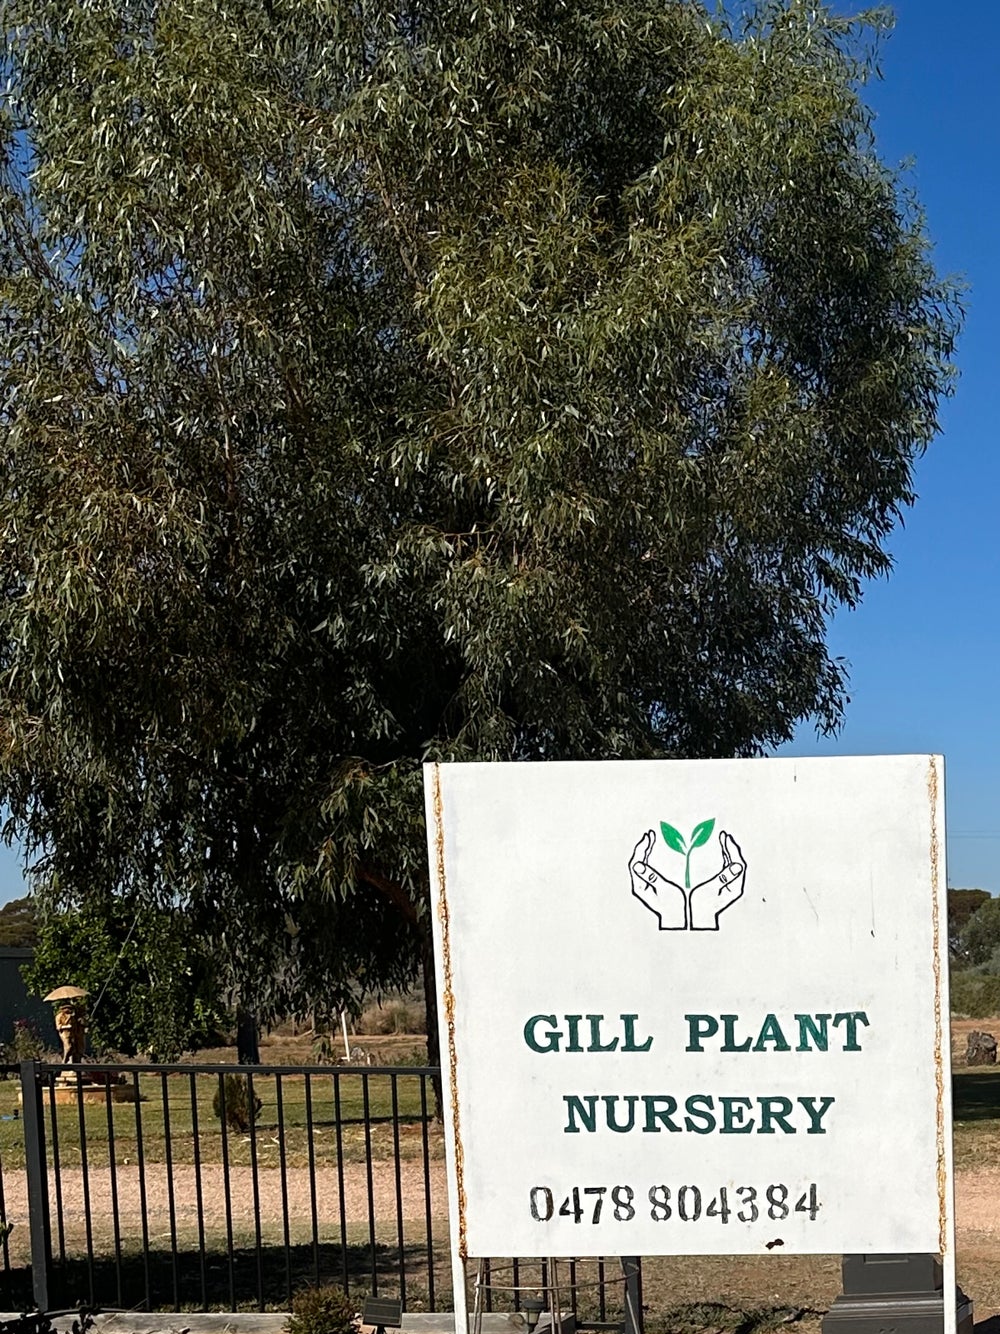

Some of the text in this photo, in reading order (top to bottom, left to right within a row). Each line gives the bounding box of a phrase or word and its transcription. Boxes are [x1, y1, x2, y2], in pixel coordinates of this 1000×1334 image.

[523, 1011, 869, 1053] GILL PLANT
[562, 1095, 835, 1134] NURSERY
[529, 1183, 820, 1225] 0478 804384
